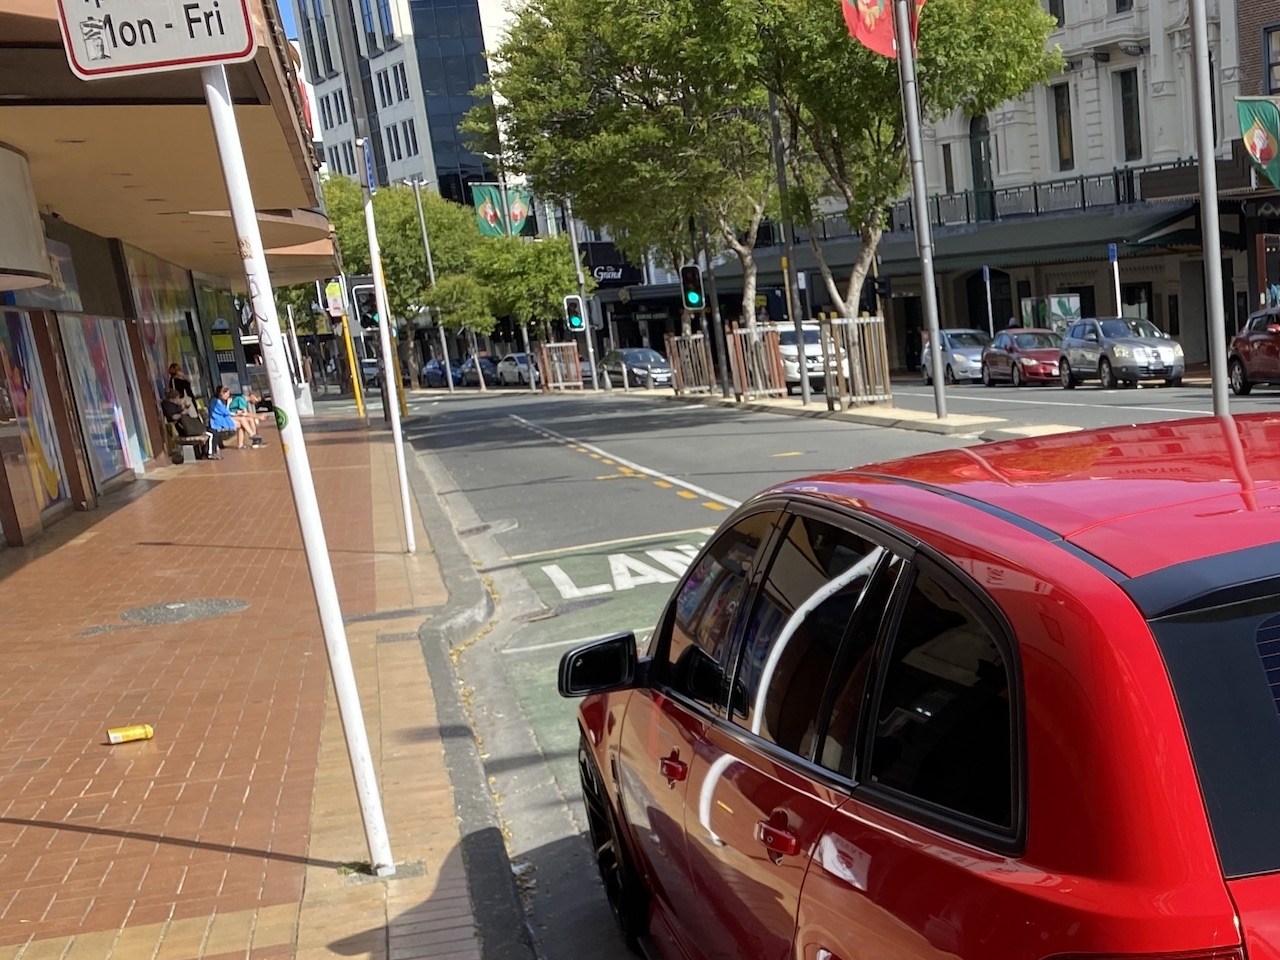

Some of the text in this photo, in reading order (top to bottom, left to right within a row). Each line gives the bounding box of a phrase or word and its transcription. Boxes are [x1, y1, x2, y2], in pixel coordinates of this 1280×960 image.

[183, 1, 225, 39] Fri
[593, 265, 623, 283] Grand
[541, 541, 707, 599] LAN
